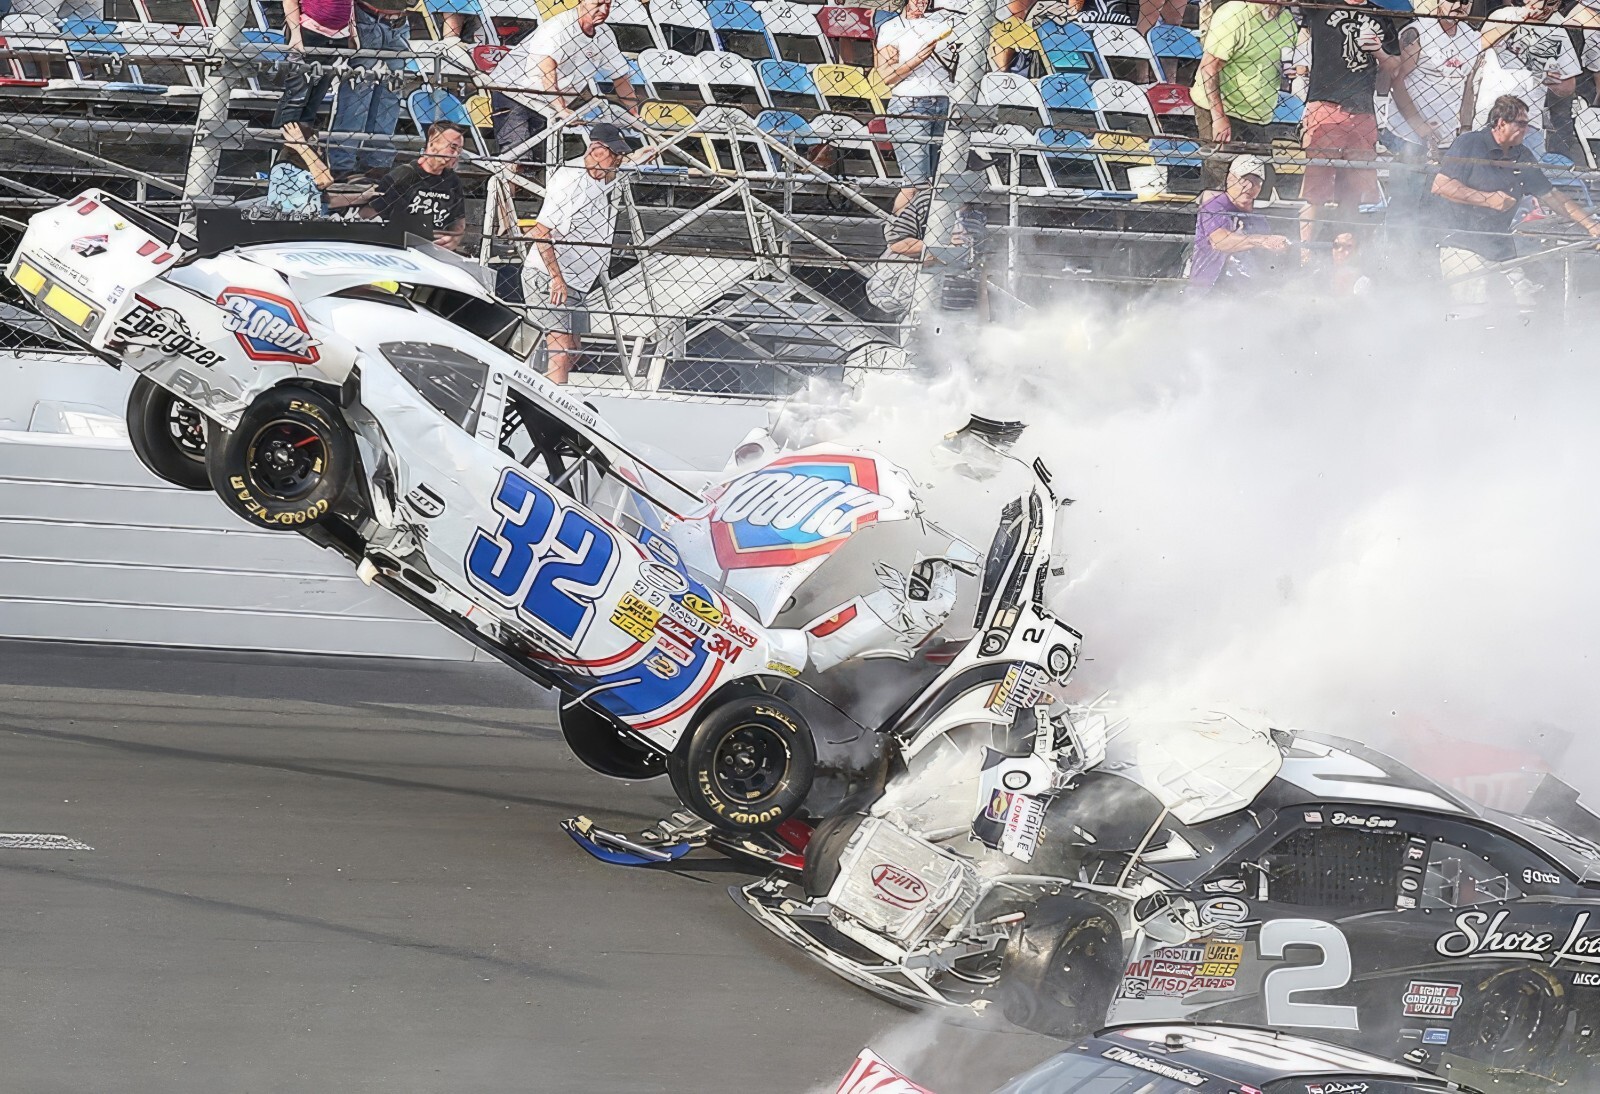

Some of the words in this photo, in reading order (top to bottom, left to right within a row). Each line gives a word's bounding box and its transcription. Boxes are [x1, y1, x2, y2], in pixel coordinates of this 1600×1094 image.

[119, 304, 228, 369] Energizer
[230, 475, 328, 524] GOODYEAR
[464, 466, 620, 655] 32
[612, 612, 654, 642] JEGS
[707, 633, 743, 664] 3M
[1435, 911, 1553, 962] Shore
[1151, 977, 1187, 992] MSD
[1195, 963, 1238, 977] JEGS
[1260, 918, 1359, 1030] 2
